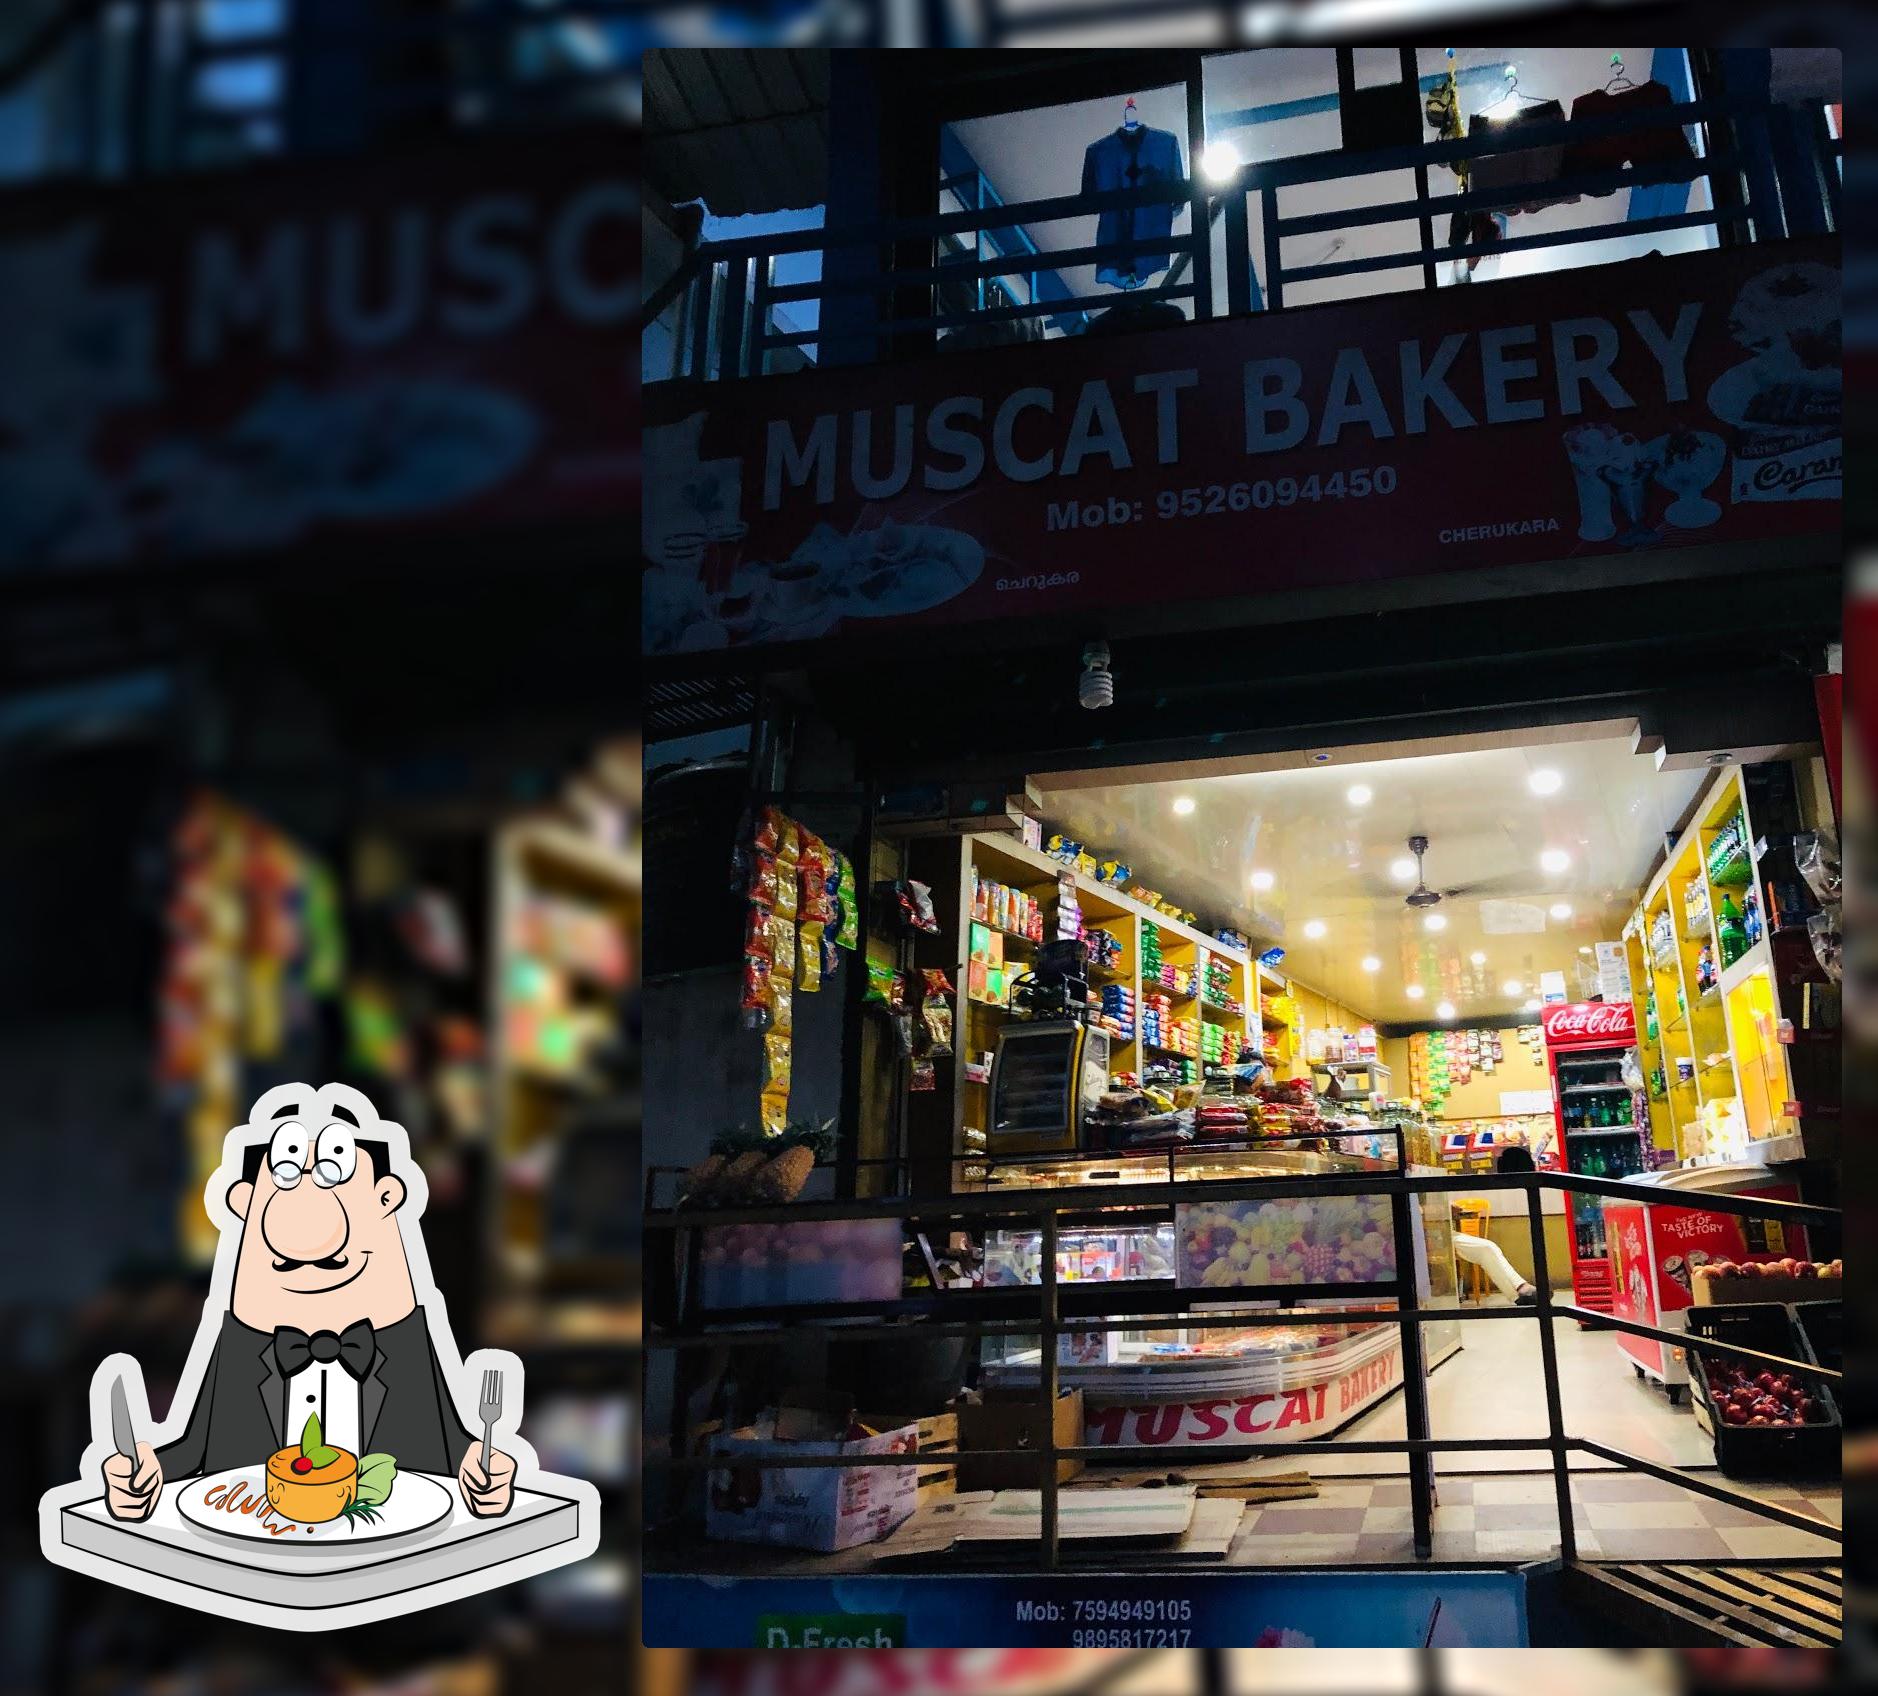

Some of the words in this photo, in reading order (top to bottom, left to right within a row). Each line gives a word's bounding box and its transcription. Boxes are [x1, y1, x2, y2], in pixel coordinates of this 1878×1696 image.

[761, 367, 1199, 512] MUSCAT
[1242, 301, 1705, 456] BAKERY
[1046, 496, 1145, 533] Mob:
[1155, 464, 1400, 523] 9526094450
[1437, 516, 1562, 545] CHERUKARA
[1660, 1222, 1694, 1233] TASTE
[1696, 1215, 1712, 1226] OF
[1676, 1223, 1725, 1239] VICTORY
[1339, 1350, 1397, 1413] BAKERY
[1016, 1600, 1066, 1621] Mob:
[1071, 1600, 1192, 1621] 7594949105
[1072, 1628, 1192, 1648] 9895817217
